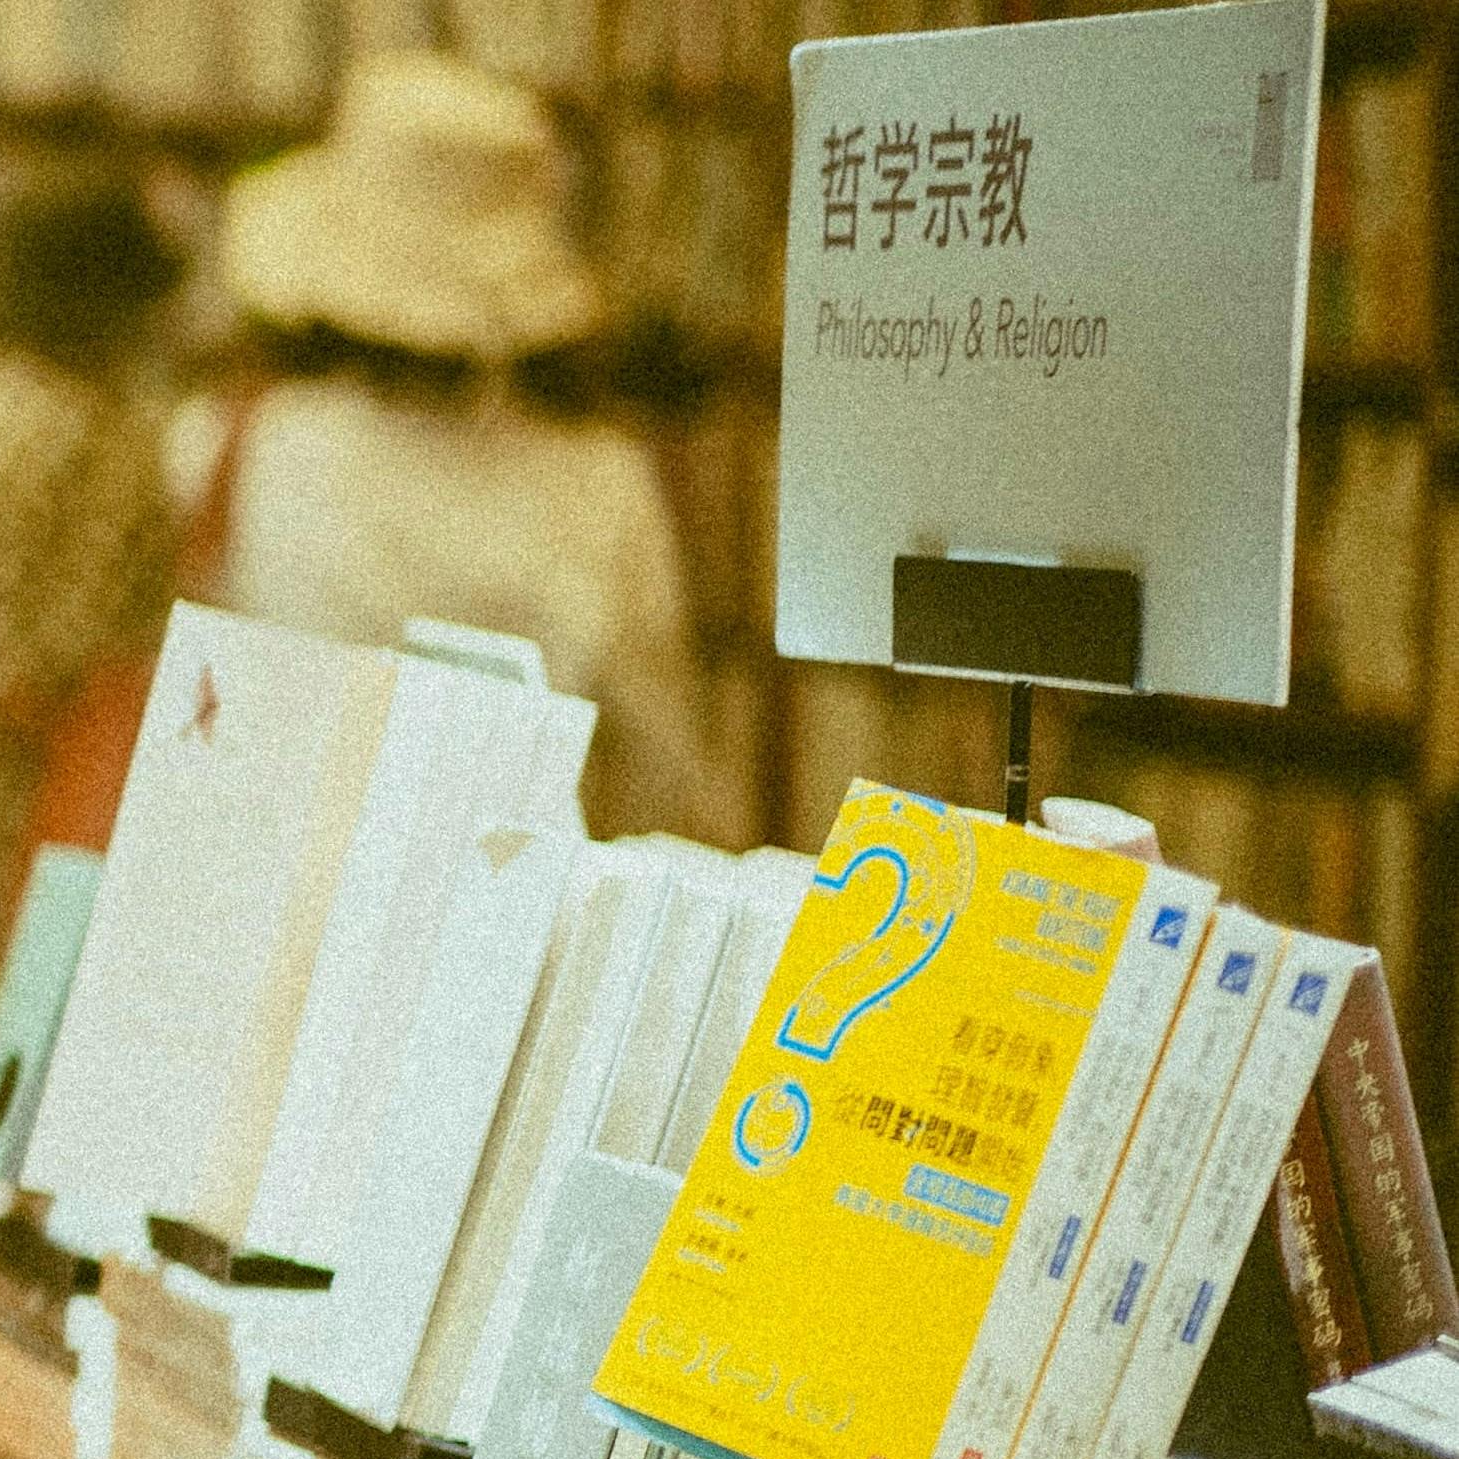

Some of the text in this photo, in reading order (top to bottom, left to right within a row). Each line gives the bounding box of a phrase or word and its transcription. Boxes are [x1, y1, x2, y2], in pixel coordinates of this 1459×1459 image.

[821, 114, 1032, 250] 哲学宗教
[816, 293, 1108, 382] Philosophy & Religion
[1281, 1136, 1342, 1348] 国的军事密码
